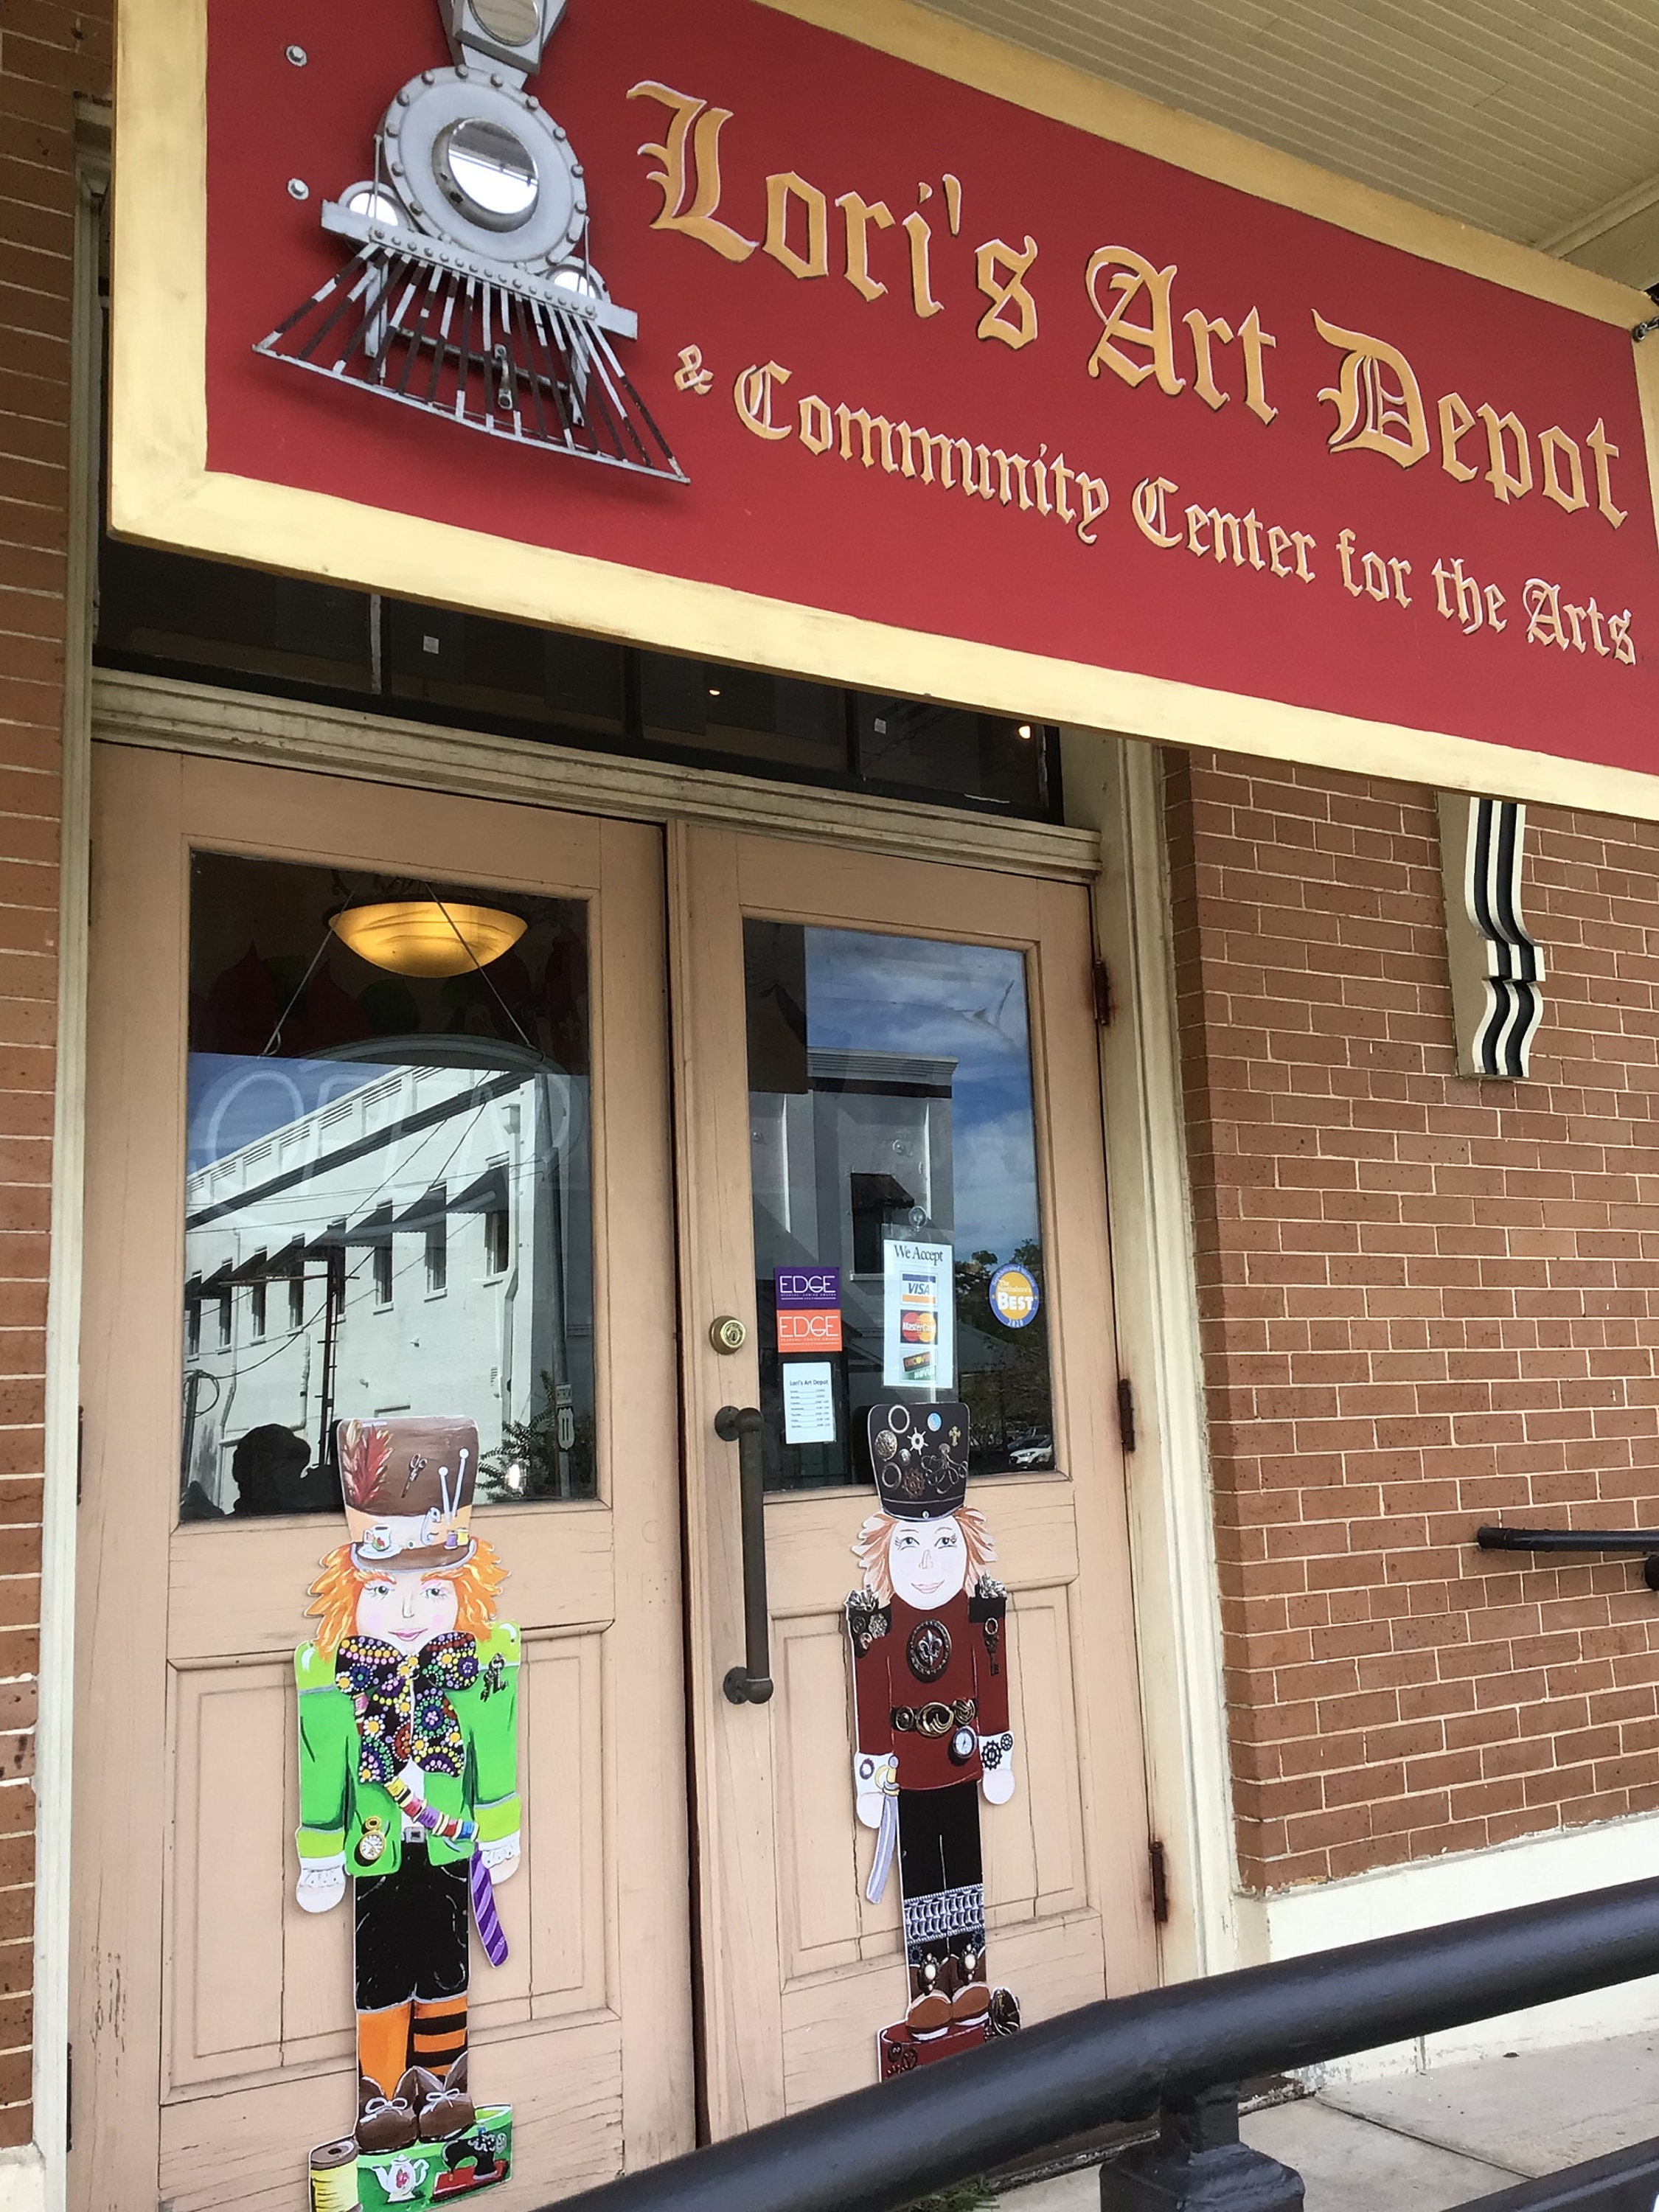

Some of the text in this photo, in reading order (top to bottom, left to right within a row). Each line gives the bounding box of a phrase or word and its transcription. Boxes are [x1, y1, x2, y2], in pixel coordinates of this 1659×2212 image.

[627, 80, 1628, 529] Lori's Art Depot
[674, 344, 1636, 665] & Community Center for the Arts
[894, 1245, 943, 1266] We Accept
[779, 1275, 835, 1293] EDGE
[908, 1282, 930, 1295] VISA
[997, 1291, 1034, 1311] BEST
[779, 1315, 838, 1337] EDGE
[1008, 1319, 1023, 1328] 2020
